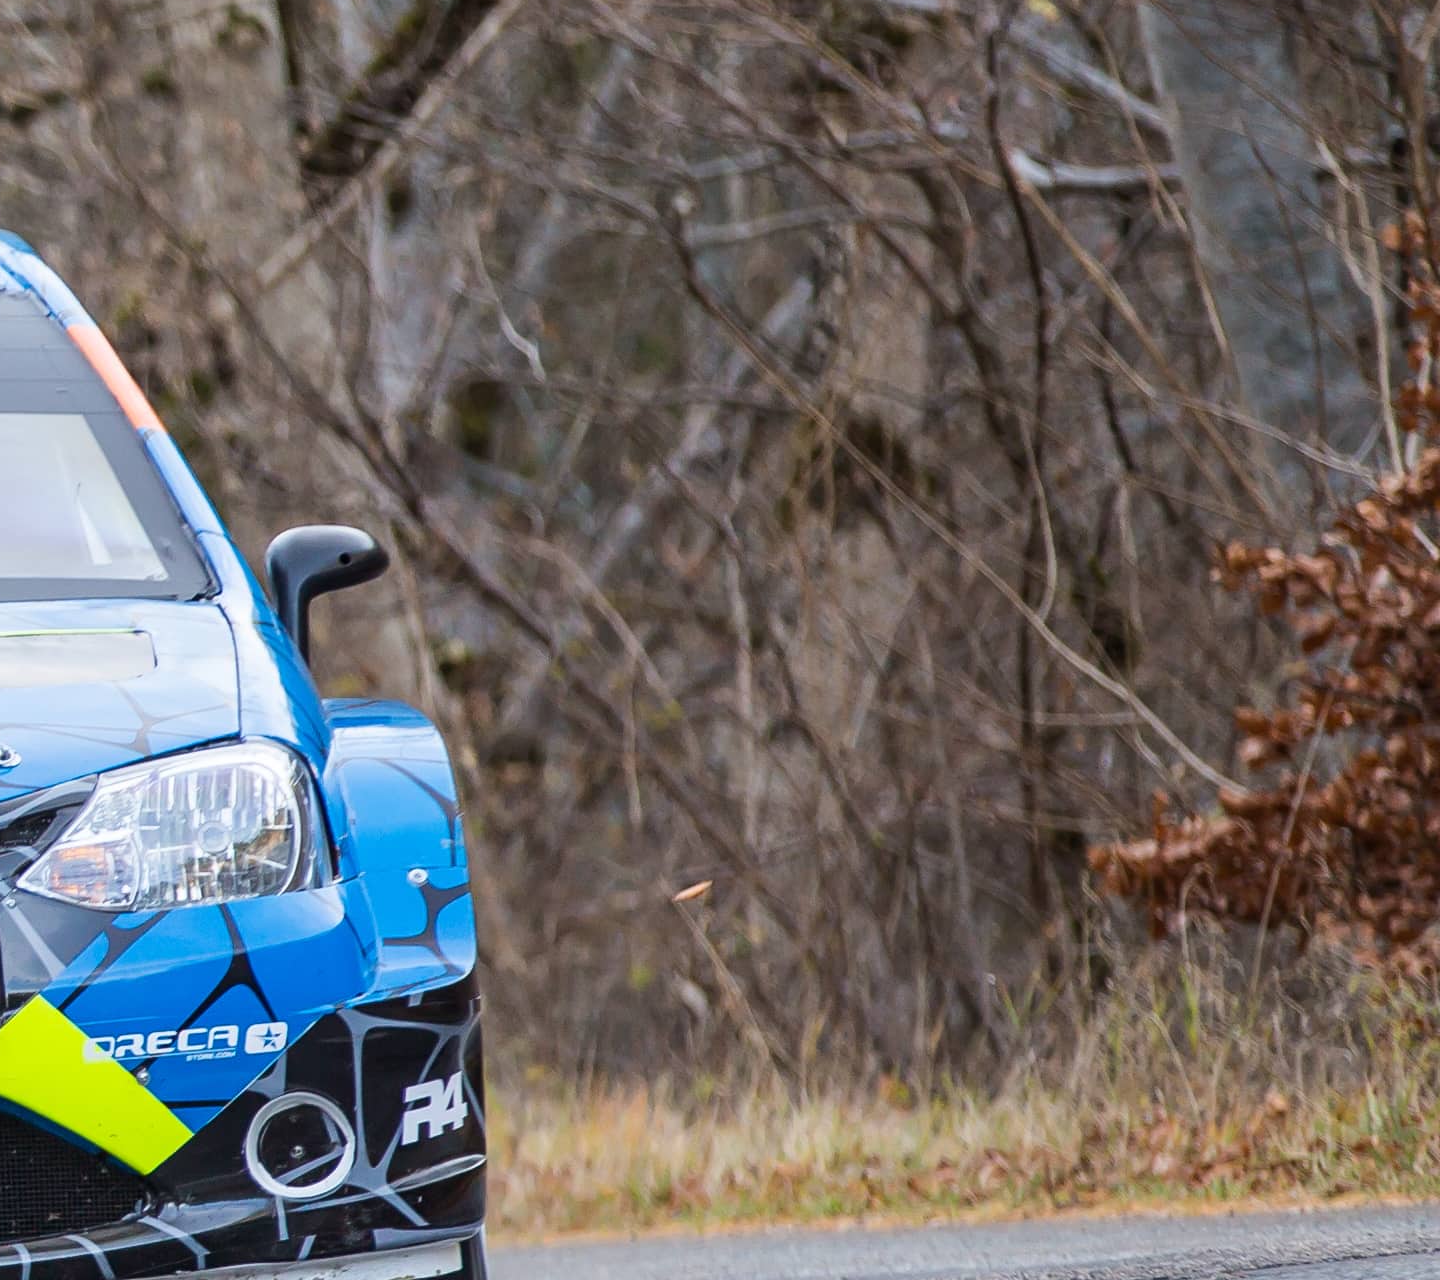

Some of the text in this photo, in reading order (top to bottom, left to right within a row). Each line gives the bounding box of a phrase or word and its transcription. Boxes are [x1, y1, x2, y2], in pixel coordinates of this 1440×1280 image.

[83, 1025, 240, 1060] ORECA
[186, 1050, 236, 1062] STORE.COM
[402, 1070, 468, 1146] R4
